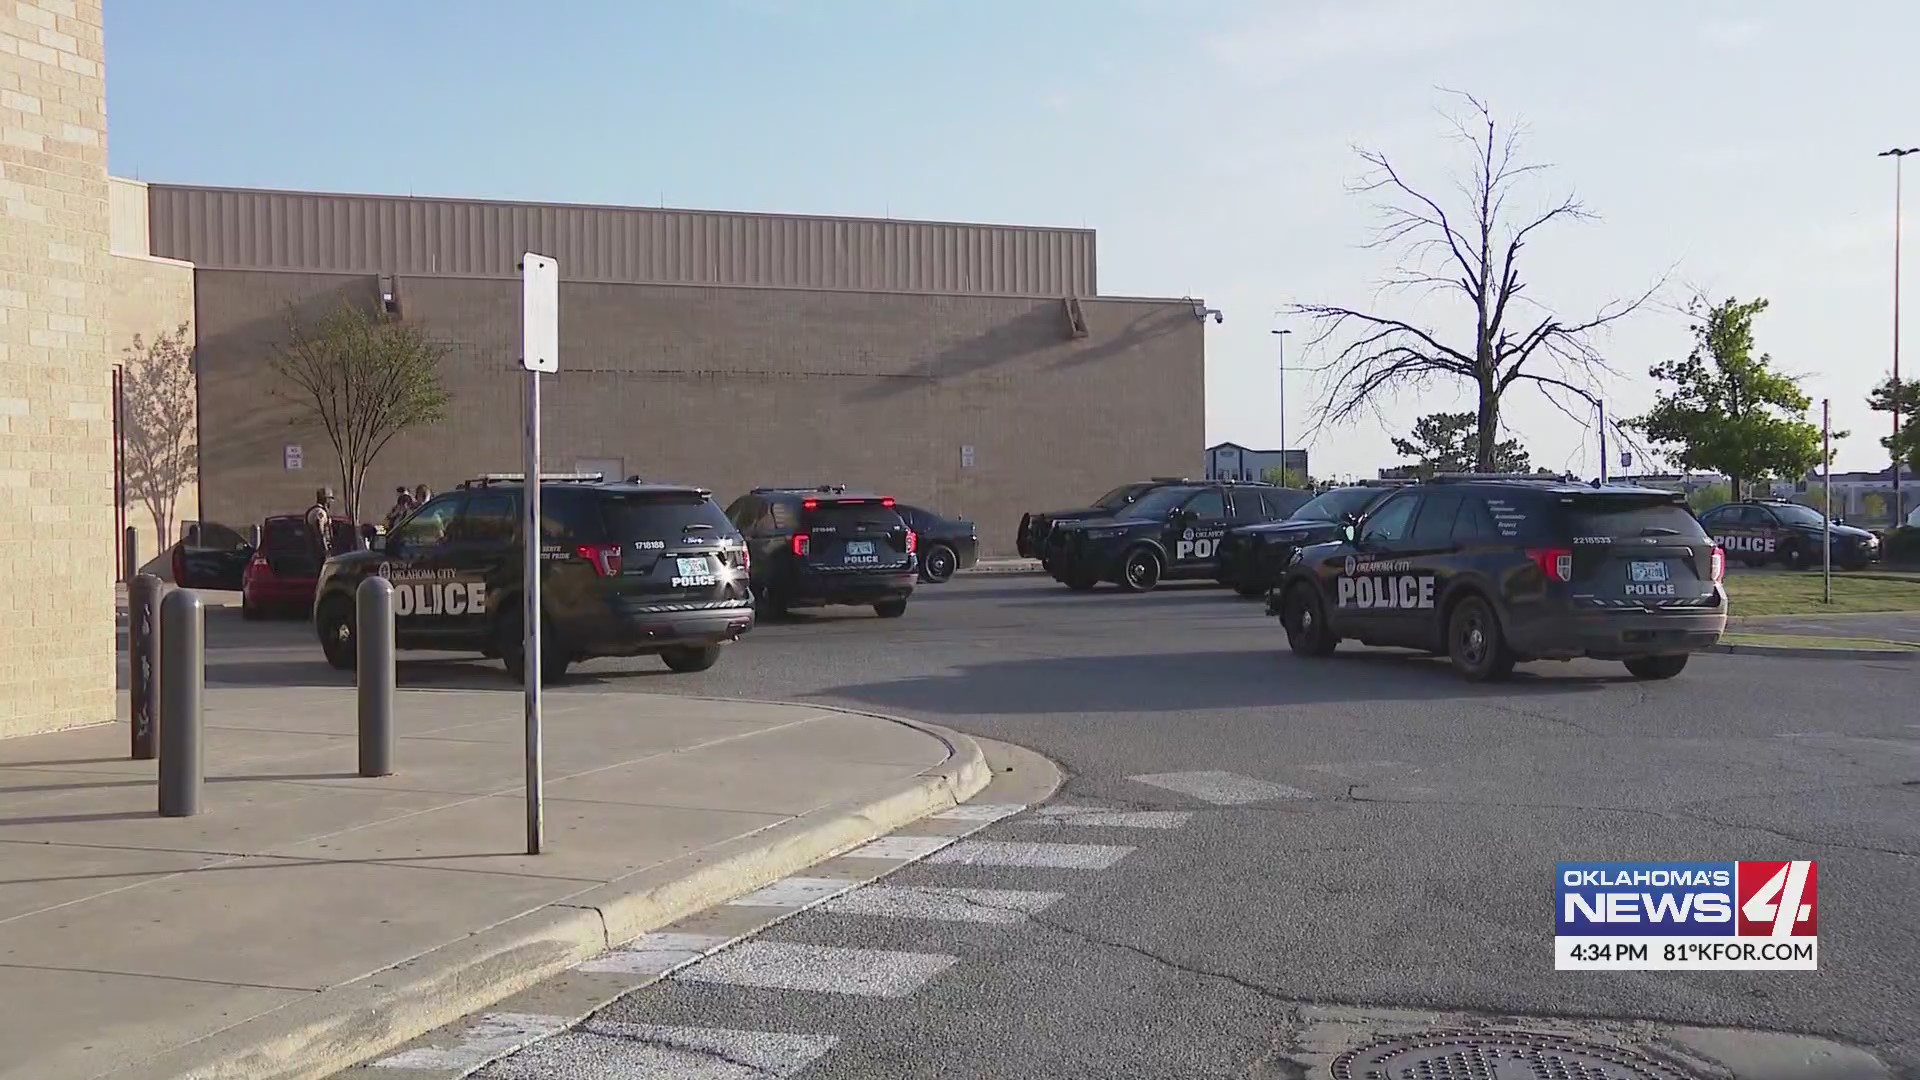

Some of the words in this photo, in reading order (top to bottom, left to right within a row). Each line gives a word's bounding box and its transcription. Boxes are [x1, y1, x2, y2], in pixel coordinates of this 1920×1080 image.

[844, 555, 878, 564] POLICE
[391, 569, 436, 581] OKLAHOMA
[437, 568, 457, 579] CITY
[671, 575, 716, 588] POLICE
[1338, 575, 1435, 609] POLICE
[1625, 584, 1675, 596] POLICE
[394, 582, 487, 617] OLICE
